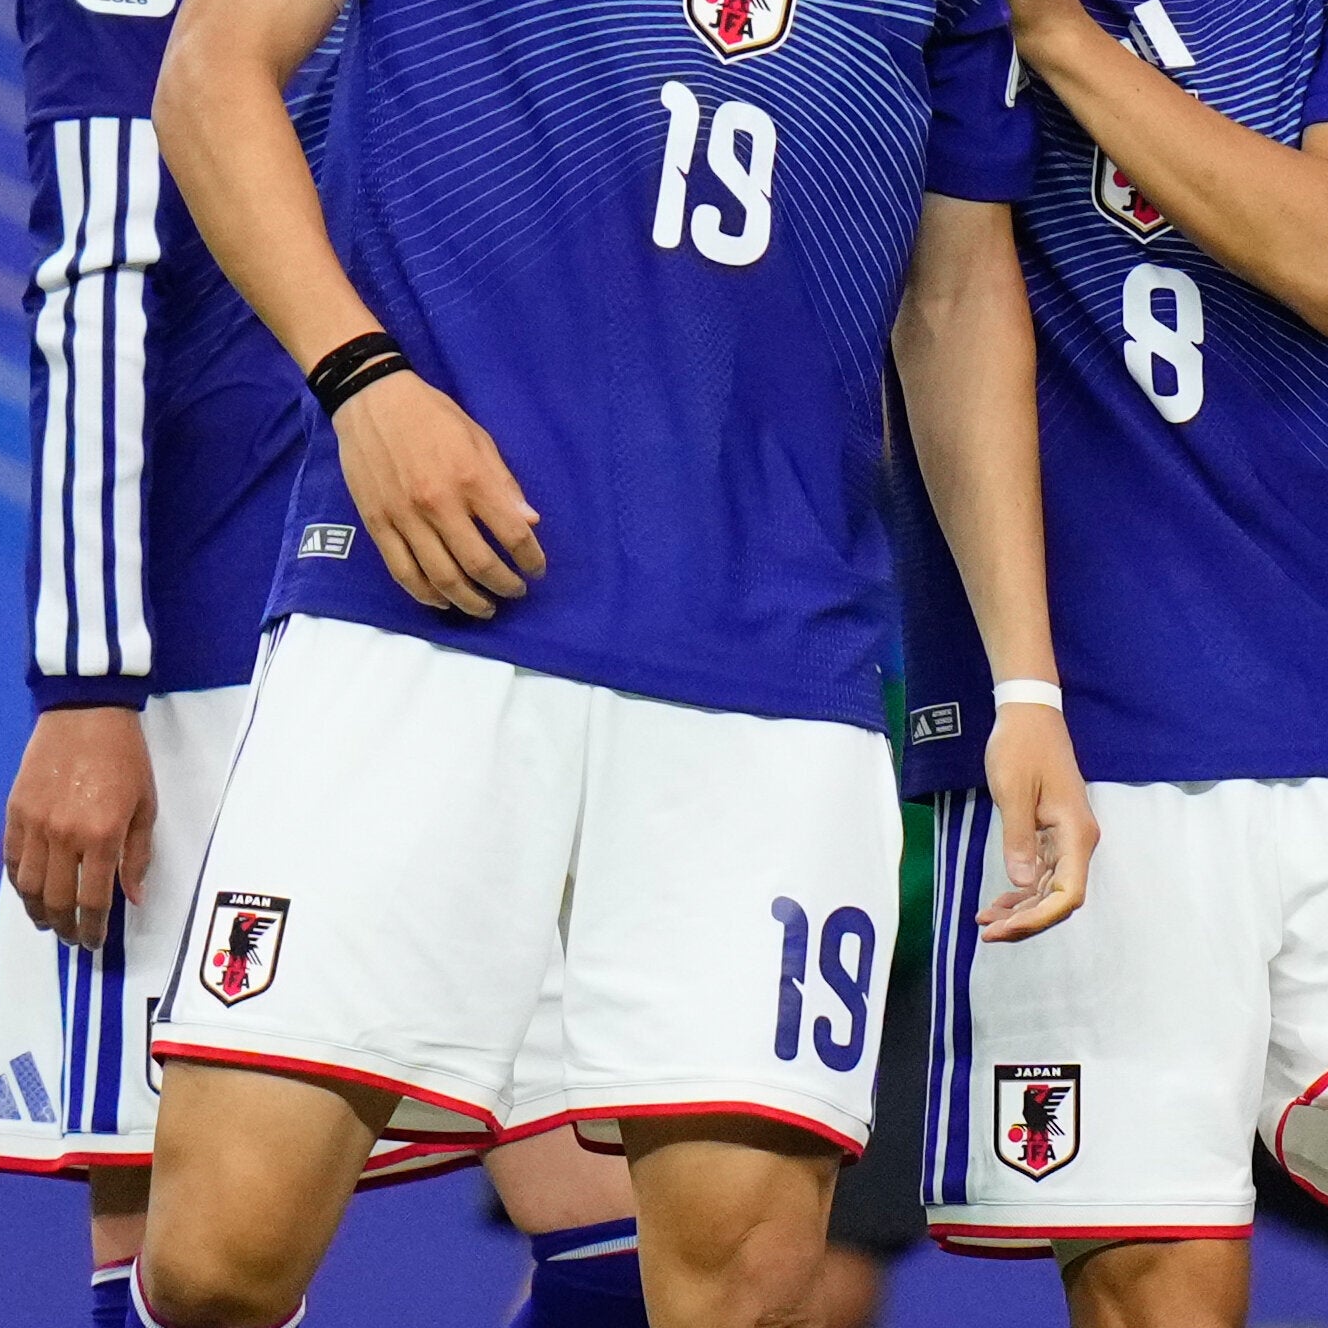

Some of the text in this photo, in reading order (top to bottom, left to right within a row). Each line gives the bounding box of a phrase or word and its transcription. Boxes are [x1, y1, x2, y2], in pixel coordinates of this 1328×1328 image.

[709, 10, 754, 39] JFA
[652, 80, 777, 266] 19
[1123, 263, 1204, 423] 8
[229, 894, 271, 908] JAPAN
[215, 970, 250, 989] JFA
[771, 895, 876, 1072] 19
[1014, 1067, 1061, 1077] JAPAN
[1017, 1144, 1057, 1161] JFA
